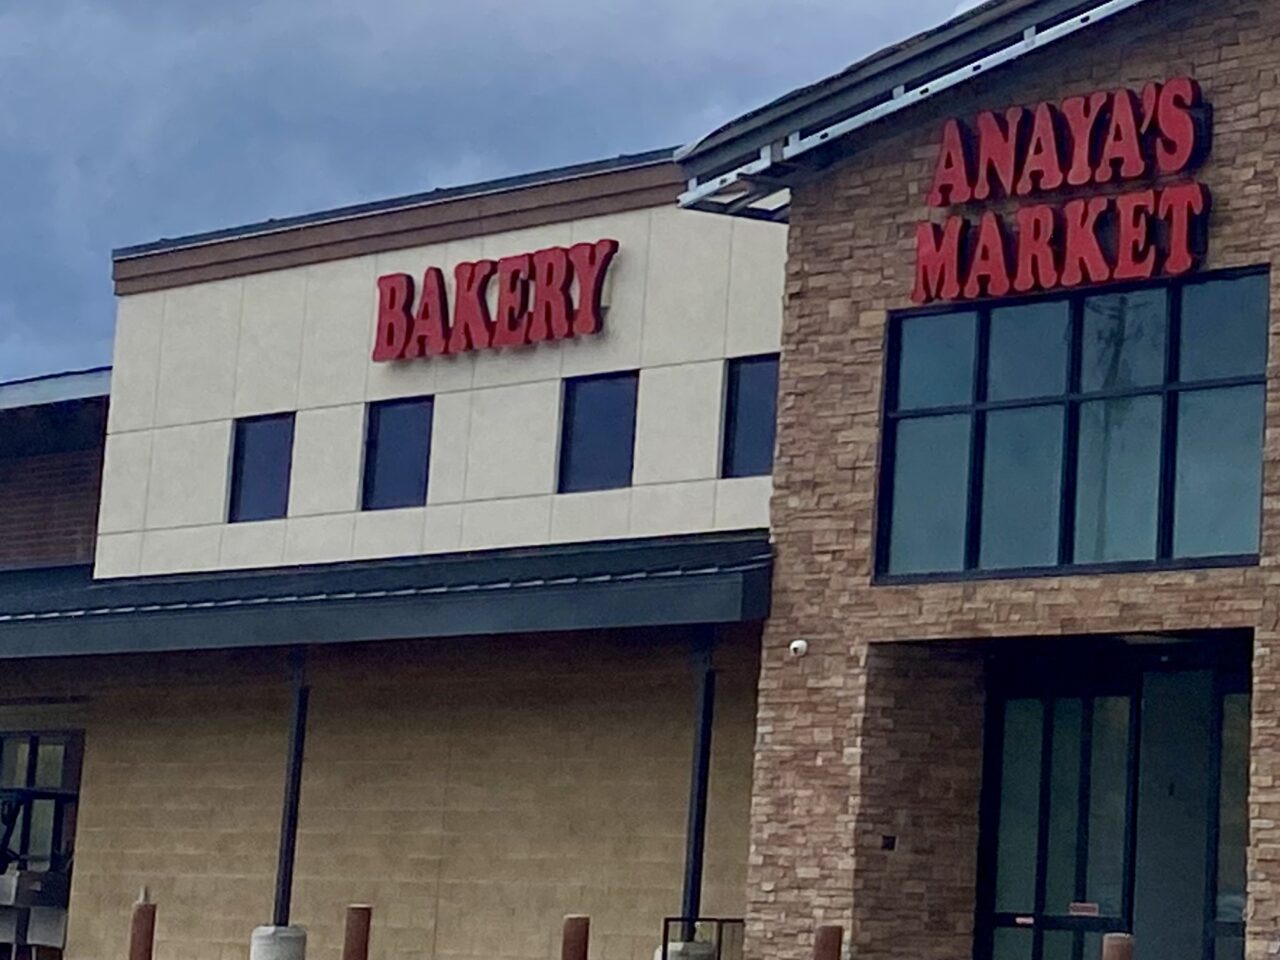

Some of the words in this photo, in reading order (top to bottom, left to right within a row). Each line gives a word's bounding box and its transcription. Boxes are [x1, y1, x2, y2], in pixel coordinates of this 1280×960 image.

[926, 76, 1201, 208] ANAYA'S
[372, 239, 619, 362] BAKERY
[911, 181, 1206, 305] MARKET
